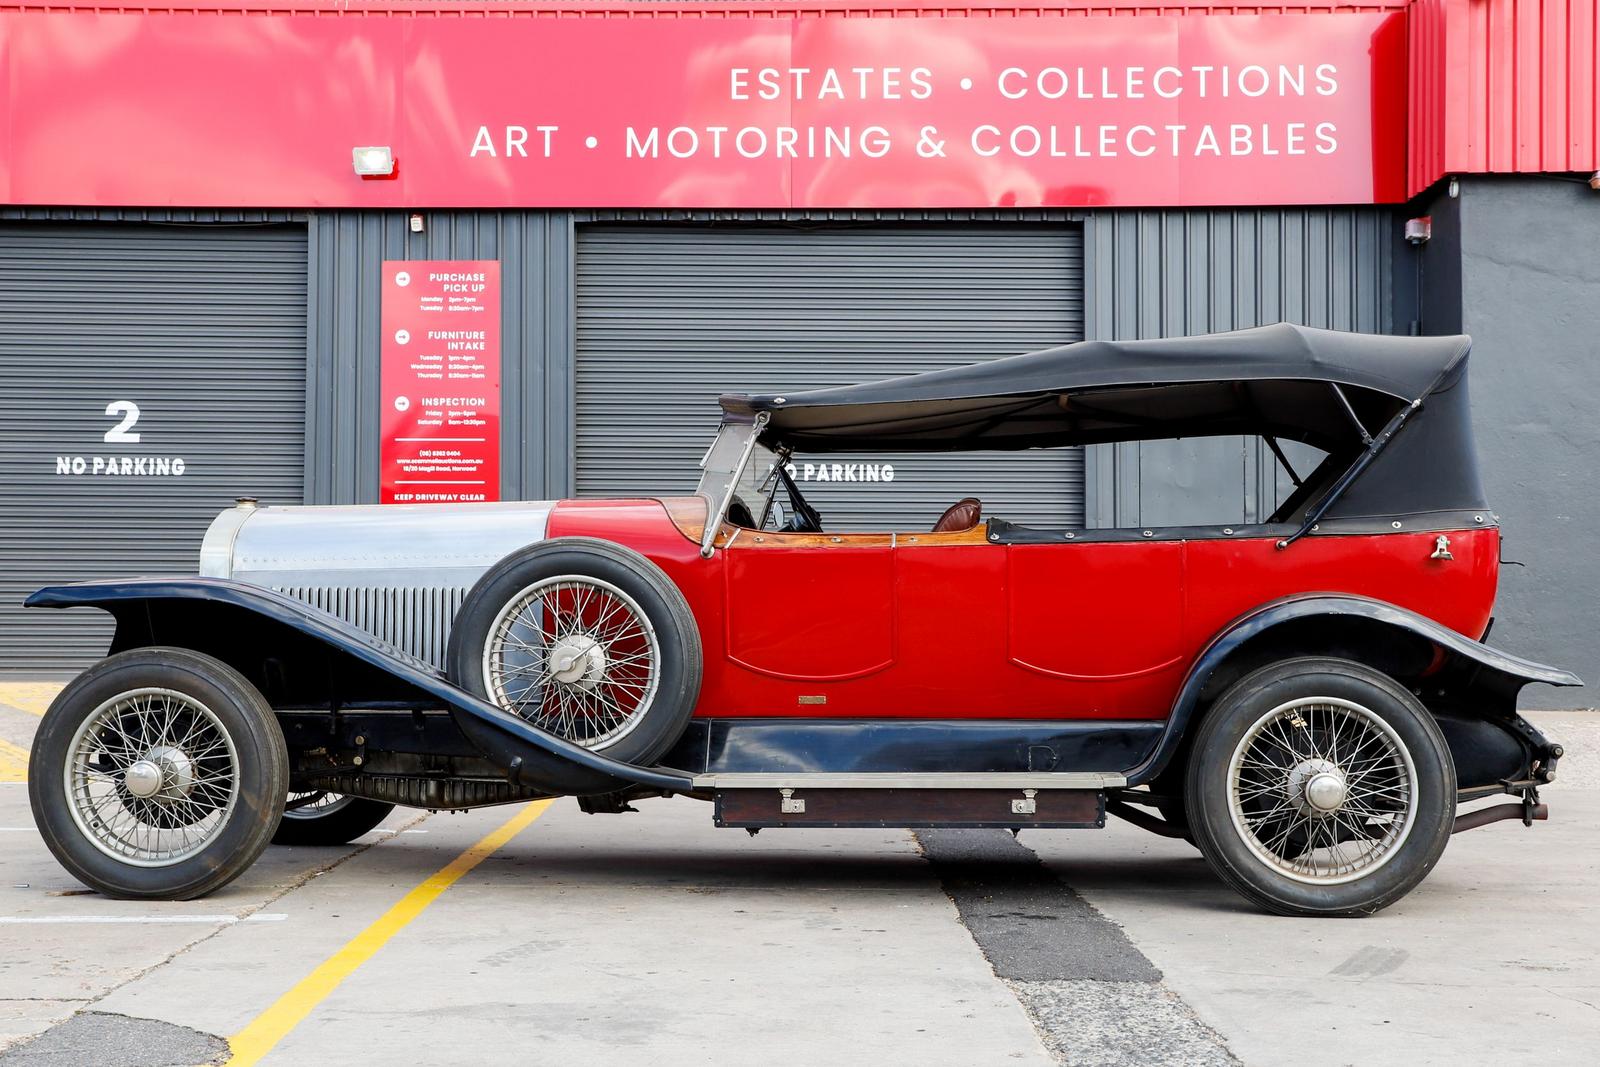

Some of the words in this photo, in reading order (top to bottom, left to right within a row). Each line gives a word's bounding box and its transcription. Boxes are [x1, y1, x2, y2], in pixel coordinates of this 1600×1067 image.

[731, 67, 933, 100] ESTATES
[998, 64, 1339, 99] COLLECTIONS
[470, 126, 559, 158] ART
[625, 126, 892, 159] MOTORING
[915, 125, 947, 158] &
[970, 122, 1338, 157] COLLECTABLES
[429, 272, 485, 282] PURCHASE
[443, 283, 468, 292] PICK
[471, 283, 486, 292] UP
[420, 296, 444, 304] Monday
[419, 305, 444, 313] Tuesday
[427, 331, 485, 340] FURNITURE
[447, 341, 485, 350] INTAKE
[419, 354, 443, 362] Tuesday
[410, 363, 443, 371] Wednesday
[417, 372, 443, 380] Thursday
[421, 397, 485, 406] INSPECTION
[104, 400, 141, 443] 2
[417, 419, 443, 427] Saturday
[56, 456, 87, 475] NO
[92, 456, 186, 476] PARKING
[803, 463, 895, 482] PARKING
[394, 493, 414, 501] KEEP
[415, 493, 459, 501] DRIVEWAY
[459, 493, 485, 501] CLEAR
